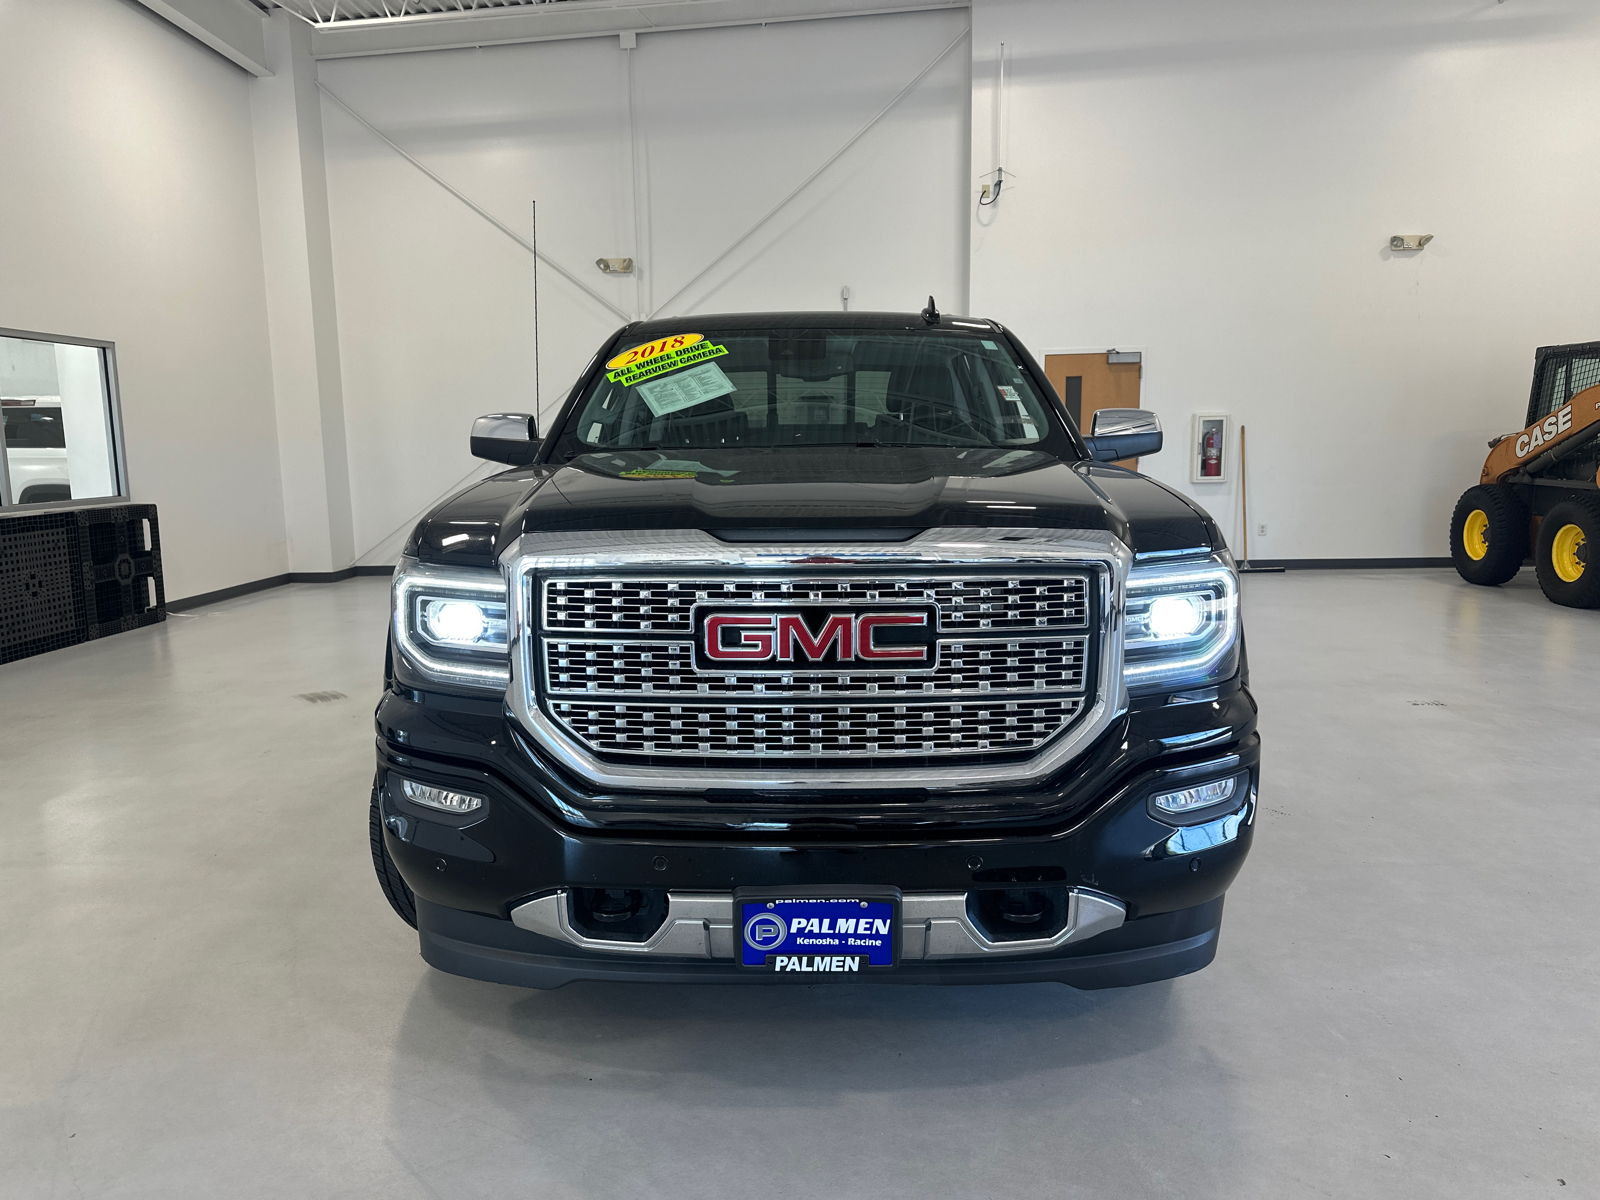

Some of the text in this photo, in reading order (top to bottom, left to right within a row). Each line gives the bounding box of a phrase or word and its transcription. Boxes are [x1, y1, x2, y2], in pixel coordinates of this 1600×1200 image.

[613, 343, 709, 379] ALL WHEEL DRIVE
[625, 336, 685, 365] 2018
[625, 347, 724, 383] REARVIEW CAMERA
[1515, 404, 1572, 458] CASE
[704, 613, 927, 662] GMC
[755, 924, 779, 941] P
[790, 918, 891, 935] PALMEN
[796, 937, 839, 945] Kenosha
[847, 938, 882, 946] Racine
[775, 956, 860, 972] PALMEN
